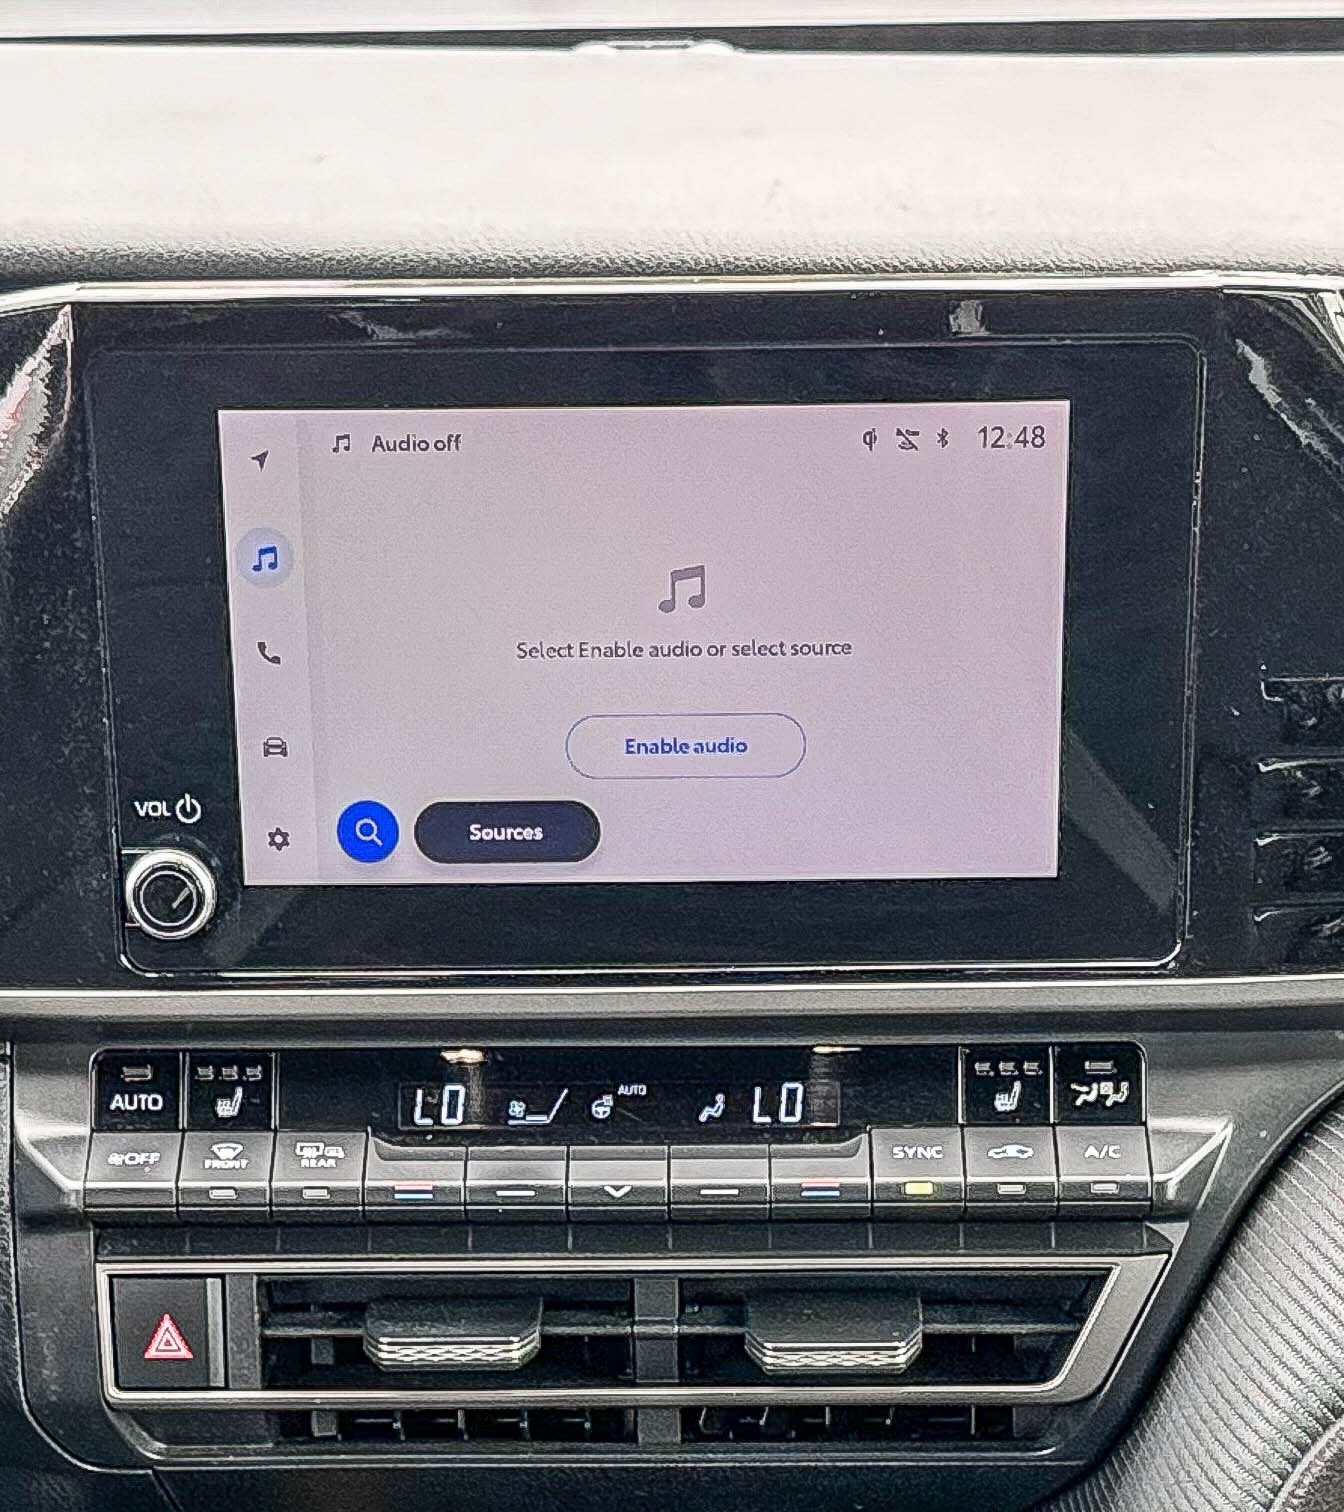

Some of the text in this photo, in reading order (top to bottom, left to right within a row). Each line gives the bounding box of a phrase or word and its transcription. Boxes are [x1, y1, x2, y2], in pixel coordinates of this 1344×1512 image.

[371, 434, 462, 452] Audio off
[977, 425, 1046, 449] 12:48
[516, 639, 852, 659] Select Enable audio or select source
[624, 737, 749, 755] Enable audio
[134, 800, 170, 817] VOL
[469, 823, 544, 841] Sources
[617, 1084, 647, 1096] AUTO
[109, 1093, 164, 1111] AUTO
[414, 1085, 465, 1126] LO
[753, 1081, 804, 1123] LO
[125, 1152, 161, 1165] OFF
[892, 1146, 944, 1159] SYNC
[1084, 1145, 1121, 1159] A/C
[203, 1158, 249, 1169] FRONT
[300, 1158, 337, 1168] REAR
